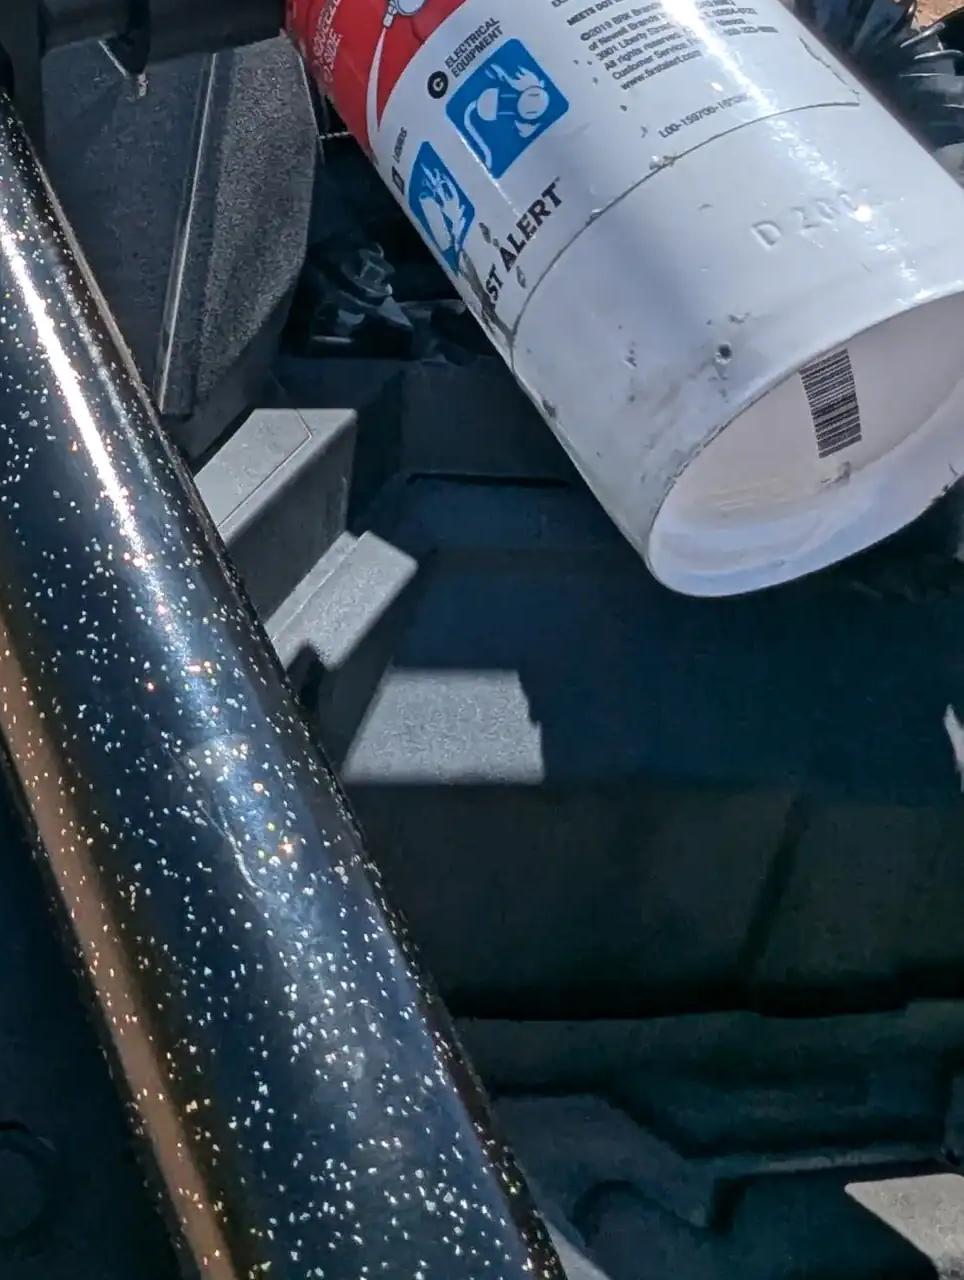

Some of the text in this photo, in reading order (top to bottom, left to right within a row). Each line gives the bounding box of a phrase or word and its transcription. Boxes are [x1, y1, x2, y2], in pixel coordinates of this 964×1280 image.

[566, 7, 595, 25] MEETS
[595, 0, 612, 10] DOT
[445, 17, 501, 70] ELECTRICAL
[452, 25, 504, 78] EQUIPMENT
[604, 59, 615, 70] All
[616, 46, 642, 63] rights
[611, 55, 653, 80] Customer
[498, 186, 563, 272] ALERT
